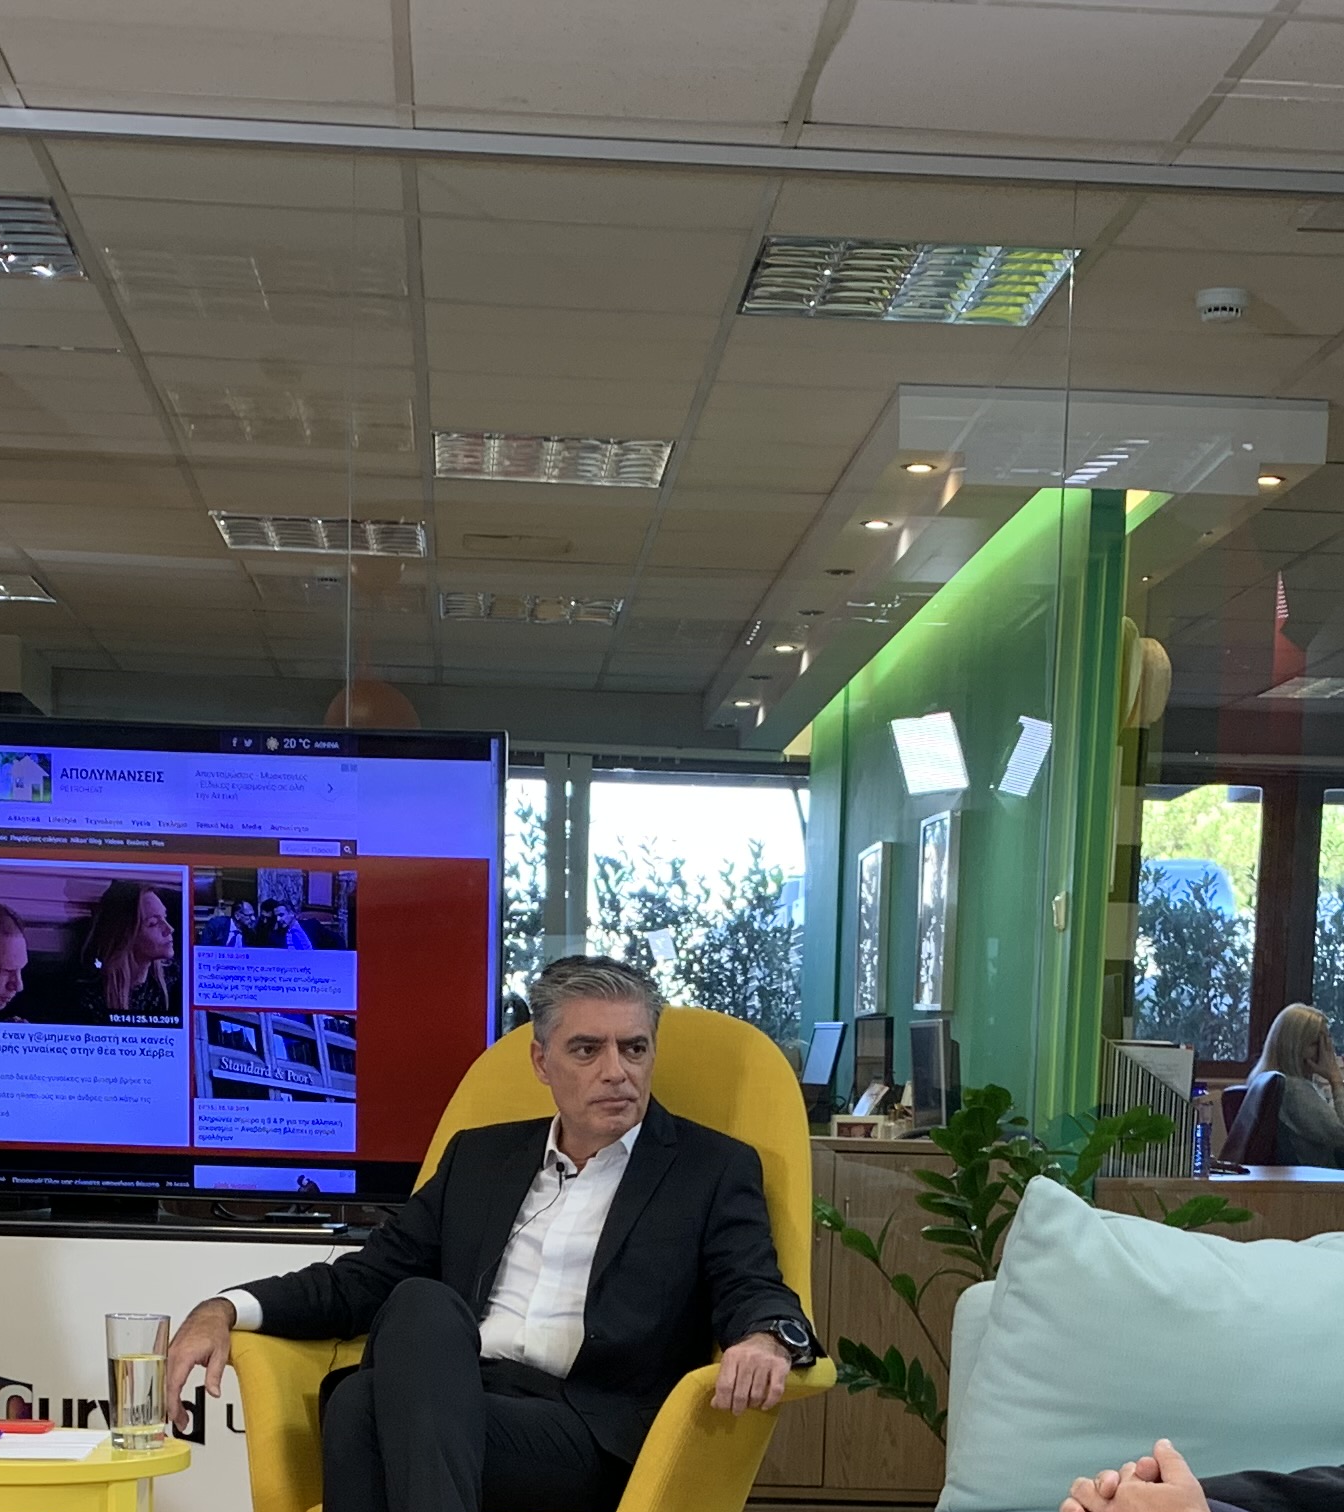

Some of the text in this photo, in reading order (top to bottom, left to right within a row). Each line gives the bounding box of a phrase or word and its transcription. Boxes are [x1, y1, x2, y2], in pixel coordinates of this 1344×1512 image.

[283, 738, 297, 749] 20
[60, 767, 165, 783] ΑΠΟΛΥΜΑΝΣΕΙΣ
[109, 1014, 131, 1023] 10:14
[136, 1015, 179, 1024] 25.10.2019
[1, 1029, 25, 1040] έναν
[70, 1046, 95, 1057] στην
[119, 1048, 136, 1057] του
[220, 1056, 272, 1078] Standard
[274, 1067, 285, 1081] &
